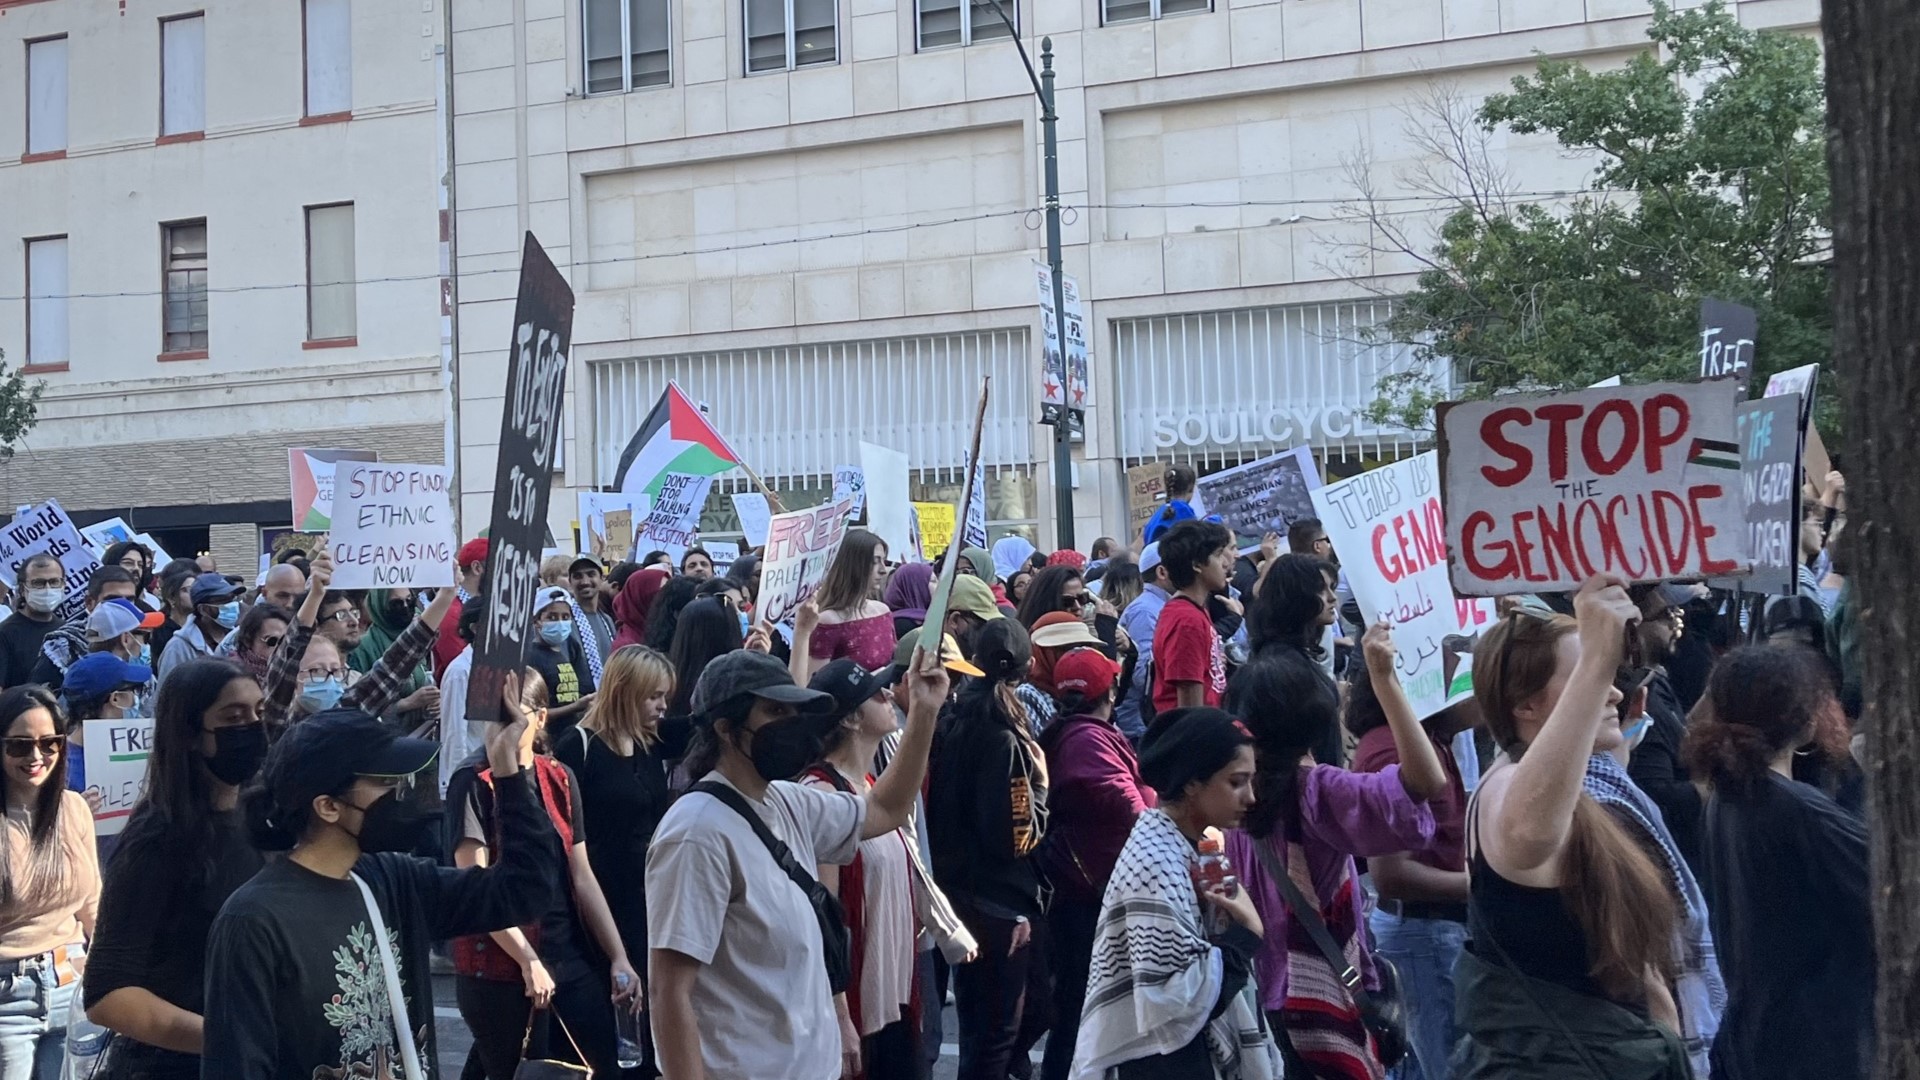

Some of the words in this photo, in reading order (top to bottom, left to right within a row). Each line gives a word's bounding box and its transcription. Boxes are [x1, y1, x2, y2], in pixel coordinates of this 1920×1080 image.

[1698, 327, 1754, 377] FREE
[1479, 392, 1692, 488] STOP
[1747, 411, 1775, 460] THE
[350, 466, 405, 499] STOP
[659, 487, 681, 501] STOP
[1218, 478, 1283, 505] PALESTINIAN
[1326, 466, 1401, 530] THIS
[1409, 455, 1432, 498] IS
[1555, 479, 1604, 499] THE
[1759, 461, 1791, 506] GAZA
[357, 503, 436, 530] ETHNIC
[645, 511, 680, 527] ABOUT
[653, 498, 691, 516] TALKING
[1239, 498, 1269, 513] LIVES
[1239, 508, 1281, 528] MATTER
[8, 505, 63, 549] World
[766, 498, 851, 563] FREE
[1461, 484, 1738, 583] GENOCIDE
[10, 538, 71, 574] Sds
[333, 542, 449, 566] CLEANSING
[1747, 520, 1791, 568] LDREN
[373, 565, 416, 586] NOW
